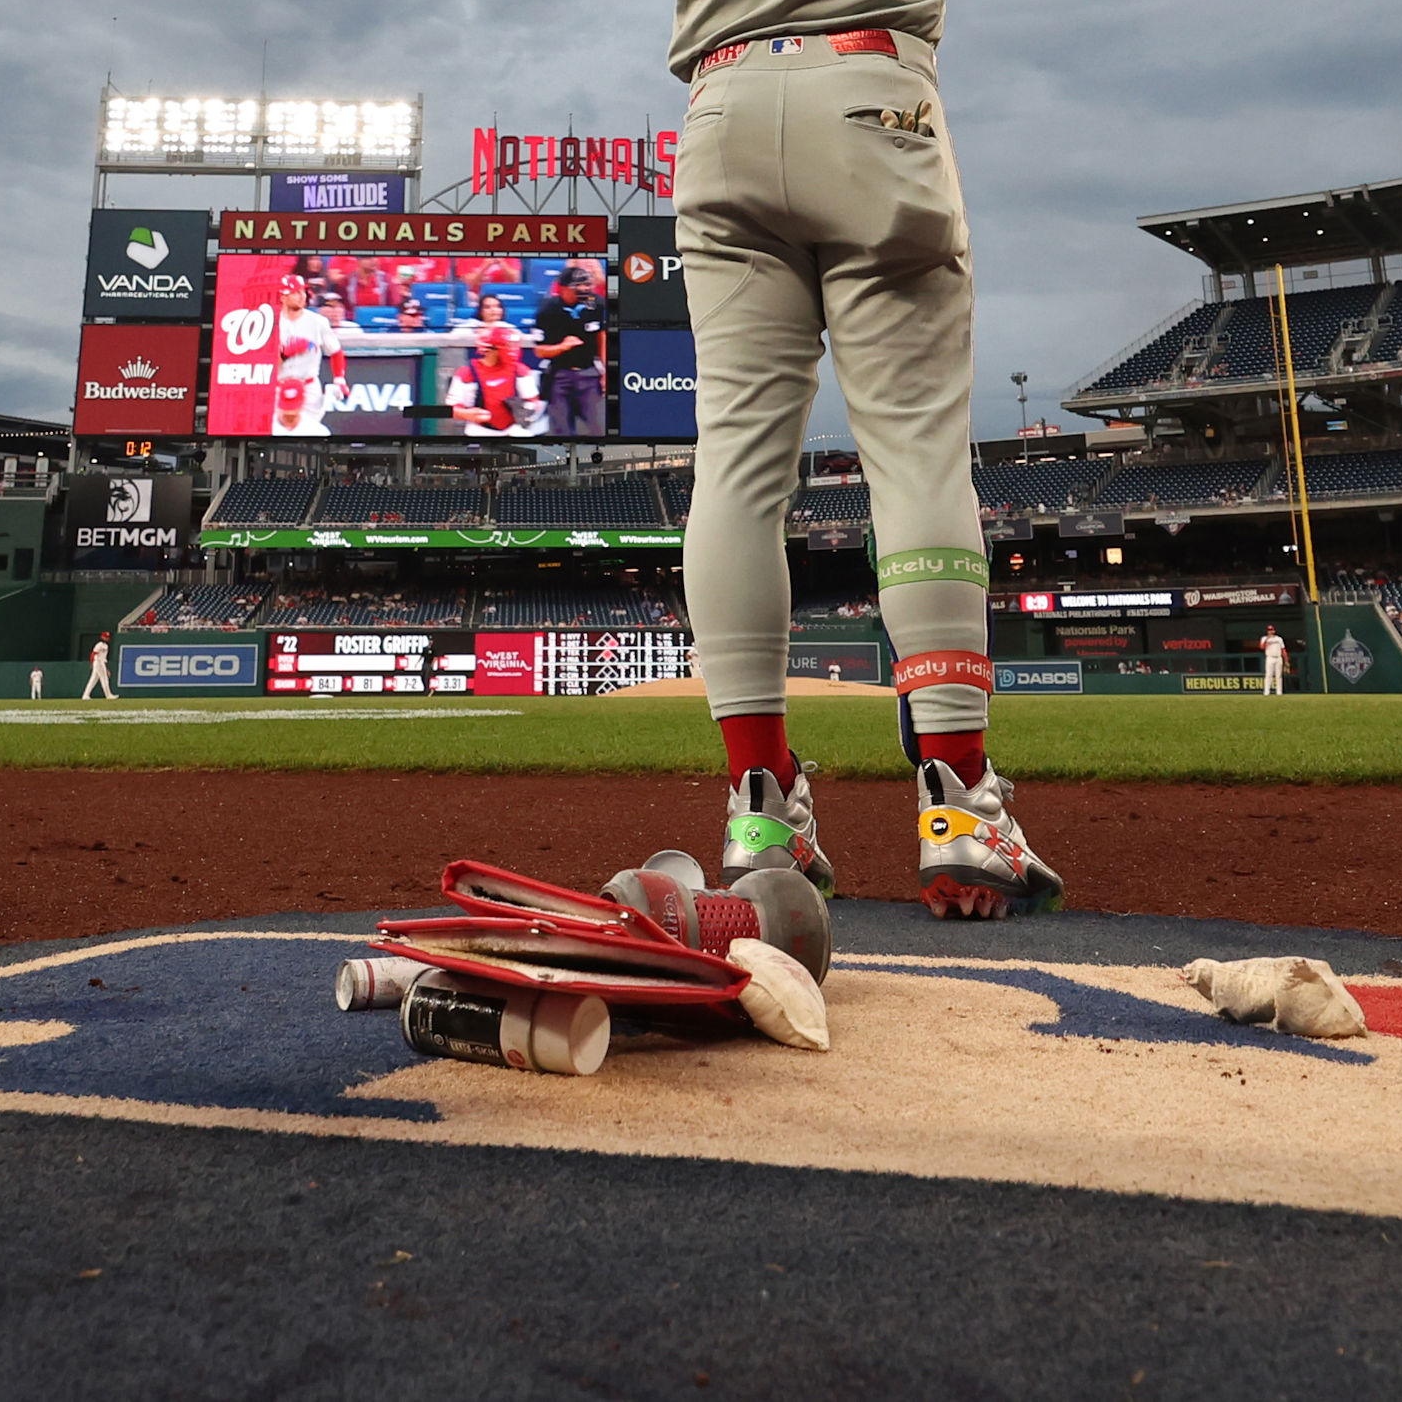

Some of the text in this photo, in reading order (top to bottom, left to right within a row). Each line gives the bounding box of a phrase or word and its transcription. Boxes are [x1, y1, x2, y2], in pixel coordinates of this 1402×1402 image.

[472, 127, 678, 198] NATIONALS
[286, 173, 349, 185] SHOW SOME
[303, 182, 389, 209] NATITUDE
[234, 219, 587, 245] NATIONALS PARK
[98, 274, 194, 292] VANDA
[100, 291, 175, 299] PHARMACEUTICALS
[217, 364, 274, 385] REPLAY
[623, 372, 697, 393] Qualco
[84, 381, 188, 400] Budweiser
[126, 441, 152, 458] 0:12
[76, 527, 177, 547] BETMGM
[313, 530, 341, 539] WEST
[365, 535, 429, 544] WVtourism.com
[571, 530, 599, 539] WEST
[619, 535, 682, 544] WVtourism.com
[306, 538, 352, 548] VIRGINIA
[564, 537, 610, 548] VIRGINIA
[1060, 594, 1097, 608] WELCOME
[1097, 594, 1107, 607] TO
[1108, 593, 1150, 607] NATIONALS
[1151, 592, 1173, 606] PARK
[1203, 589, 1258, 601] WASHINGTON
[1228, 593, 1276, 605] NATIONALS
[1055, 624, 1136, 635] Nationals Park
[277, 635, 298, 653] #22
[335, 634, 382, 654] FOSTER
[1114, 636, 1128, 648] by
[1162, 638, 1212, 650] verizon
[486, 651, 520, 660] WEST
[134, 655, 240, 677] GEICO
[477, 658, 533, 671] VIRGINIA
[318, 678, 336, 690] 84.1
[363, 678, 373, 689] 81
[404, 678, 417, 689] 7-2
[444, 678, 461, 689] 3.31
[1017, 673, 1079, 685] DABOS
[1185, 677, 1278, 690] HERCULES FENE
